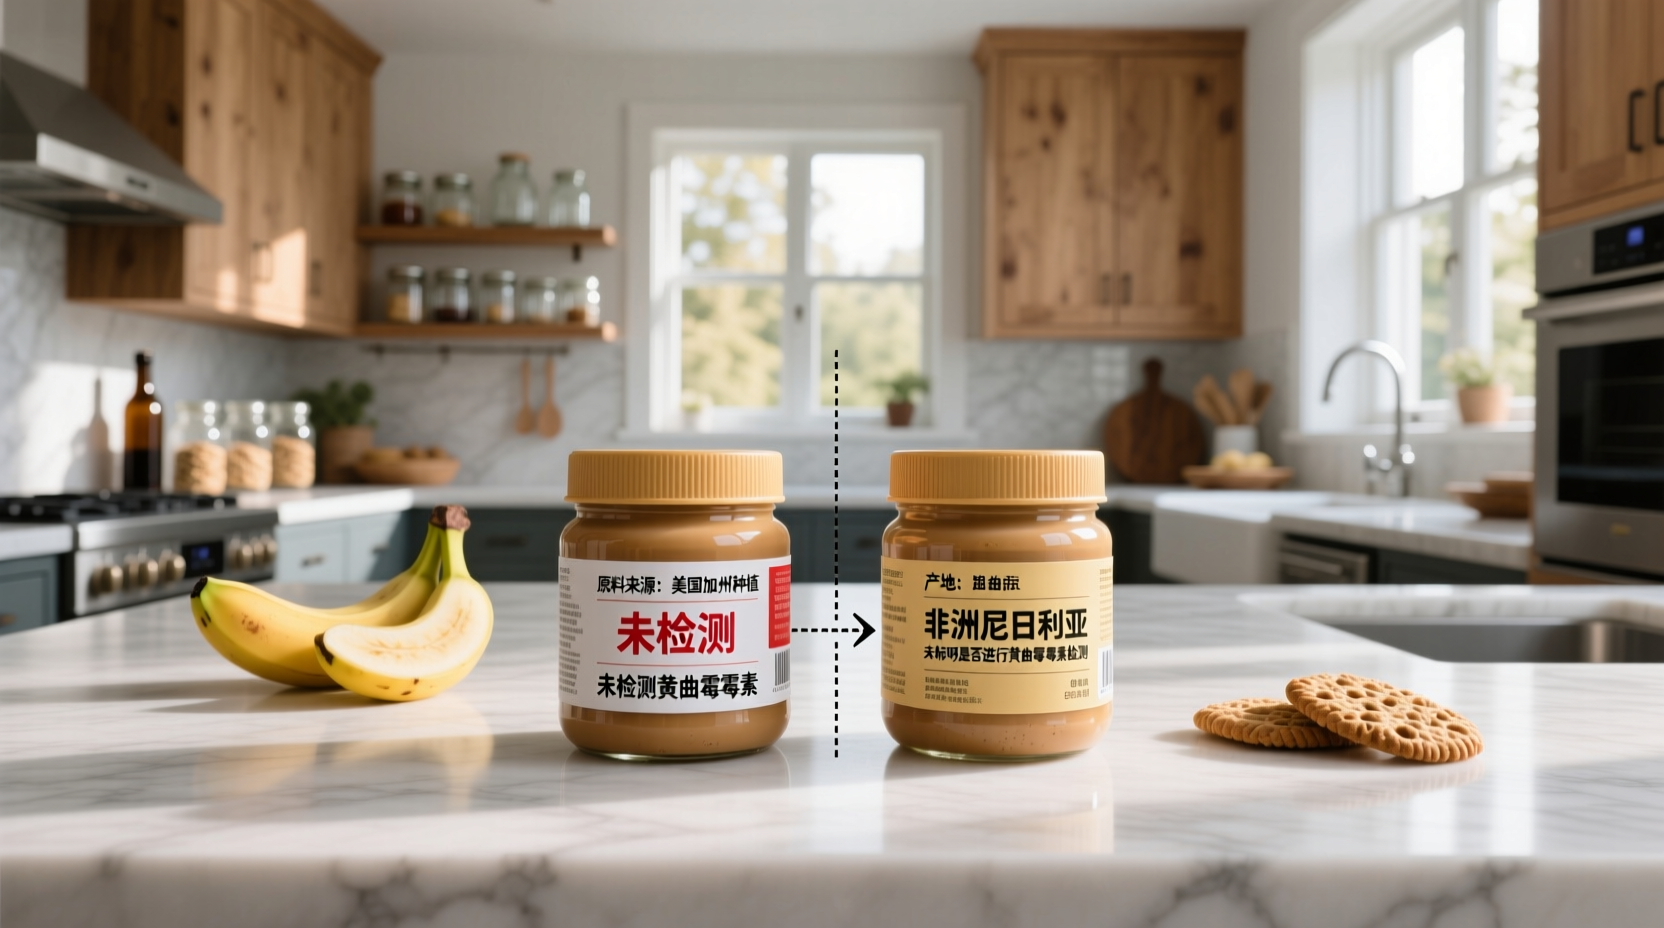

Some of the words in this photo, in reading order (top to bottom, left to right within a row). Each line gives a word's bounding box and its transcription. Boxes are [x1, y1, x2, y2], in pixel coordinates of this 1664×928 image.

[617, 611, 735, 656] 未检测
[924, 608, 1088, 641] 非洲尼日利亚
